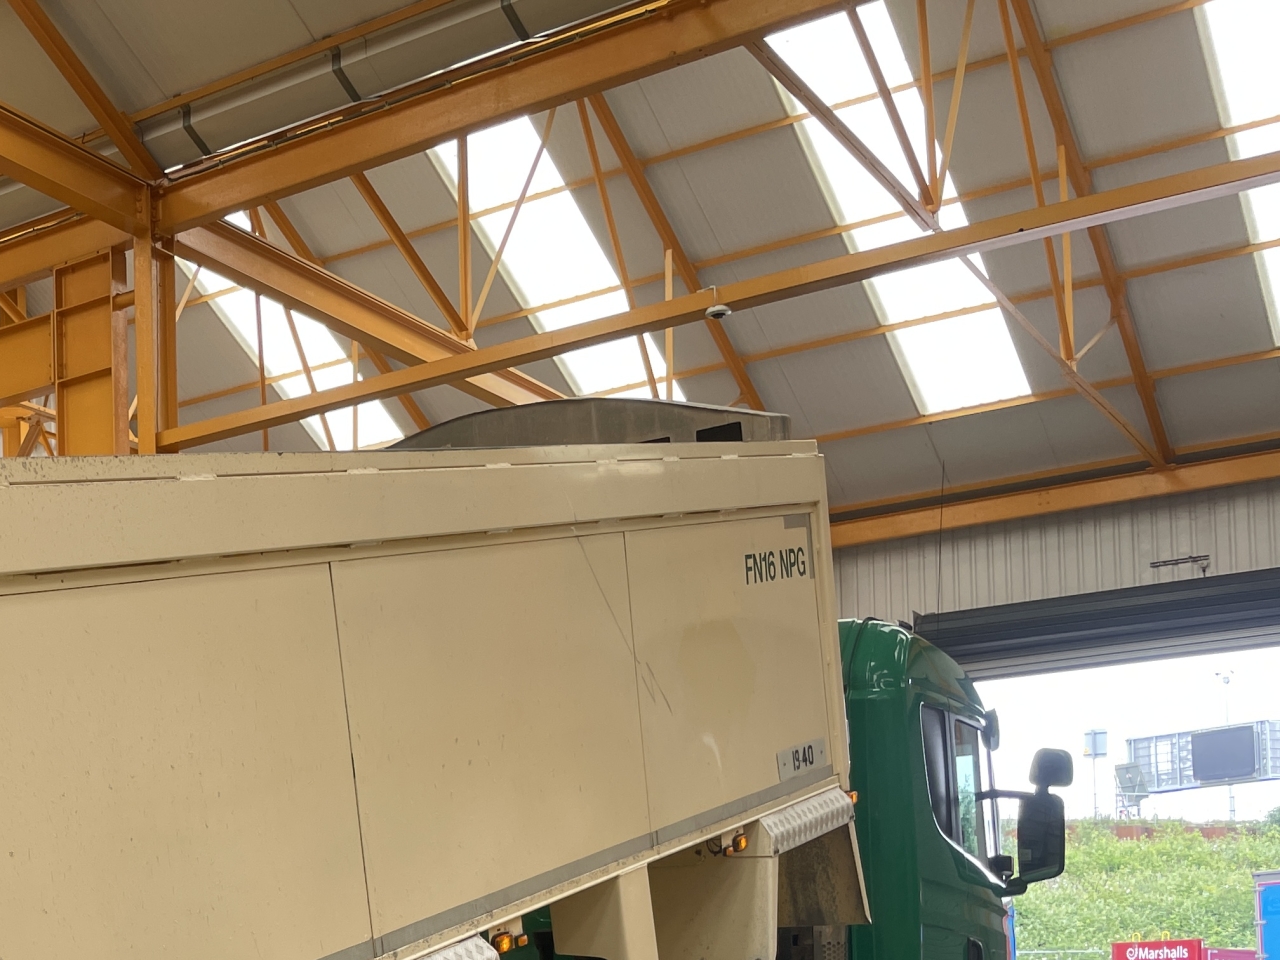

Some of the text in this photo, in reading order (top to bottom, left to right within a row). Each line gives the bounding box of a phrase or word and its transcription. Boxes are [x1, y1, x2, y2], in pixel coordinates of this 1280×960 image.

[745, 547, 806, 585] FN16 NPG
[1138, 945, 1189, 960] Marshalls
